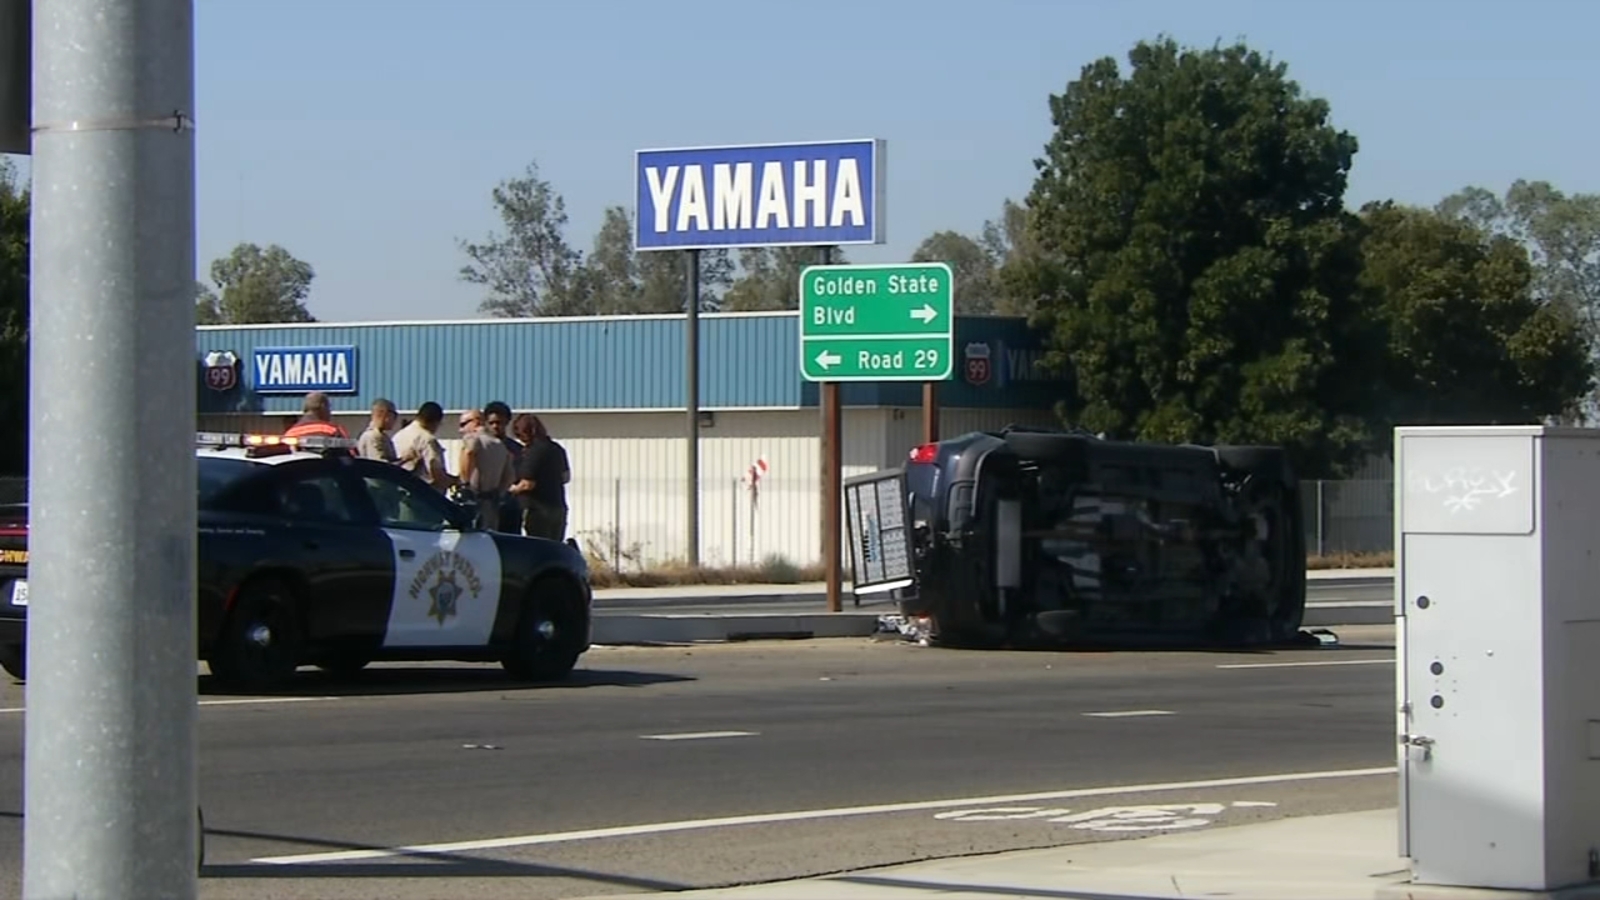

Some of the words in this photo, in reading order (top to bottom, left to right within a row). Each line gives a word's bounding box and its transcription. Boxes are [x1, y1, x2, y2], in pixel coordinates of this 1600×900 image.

[645, 158, 865, 232] YAMAHA
[813, 276, 876, 295] Golden
[888, 274, 938, 293] State
[813, 306, 855, 325] Blvd
[256, 353, 348, 385] YAMAHA
[858, 351, 903, 369] Road
[914, 349, 938, 368] 29
[211, 368, 229, 385] 99
[969, 360, 986, 379] 99
